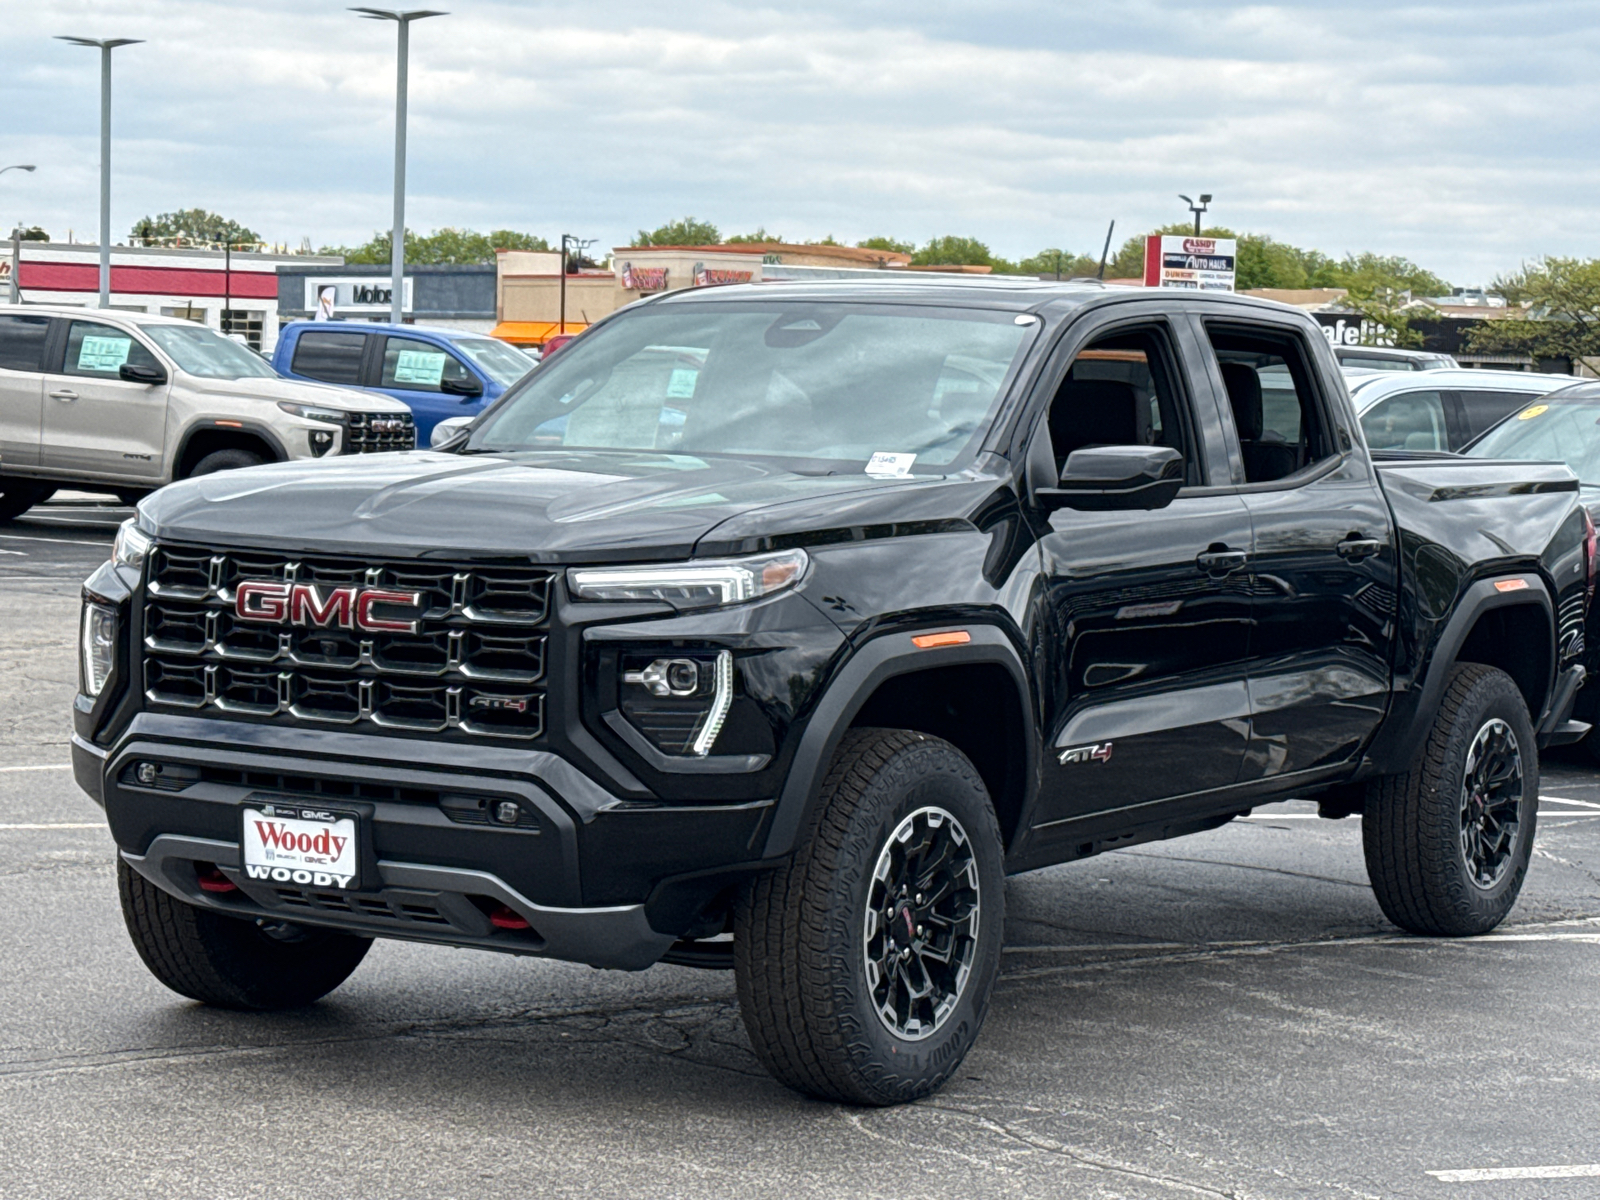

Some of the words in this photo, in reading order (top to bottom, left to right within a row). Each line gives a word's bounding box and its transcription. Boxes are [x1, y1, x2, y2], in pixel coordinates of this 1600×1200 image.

[1183, 238, 1216, 251] CASSIDY
[1185, 255, 1207, 269] AUTO
[1209, 258, 1226, 270] HAUS
[235, 581, 420, 634] GMC
[1057, 742, 1113, 765] AT4
[301, 810, 331, 820] GMC
[253, 820, 348, 863] Woody
[246, 865, 352, 889] WOODY
